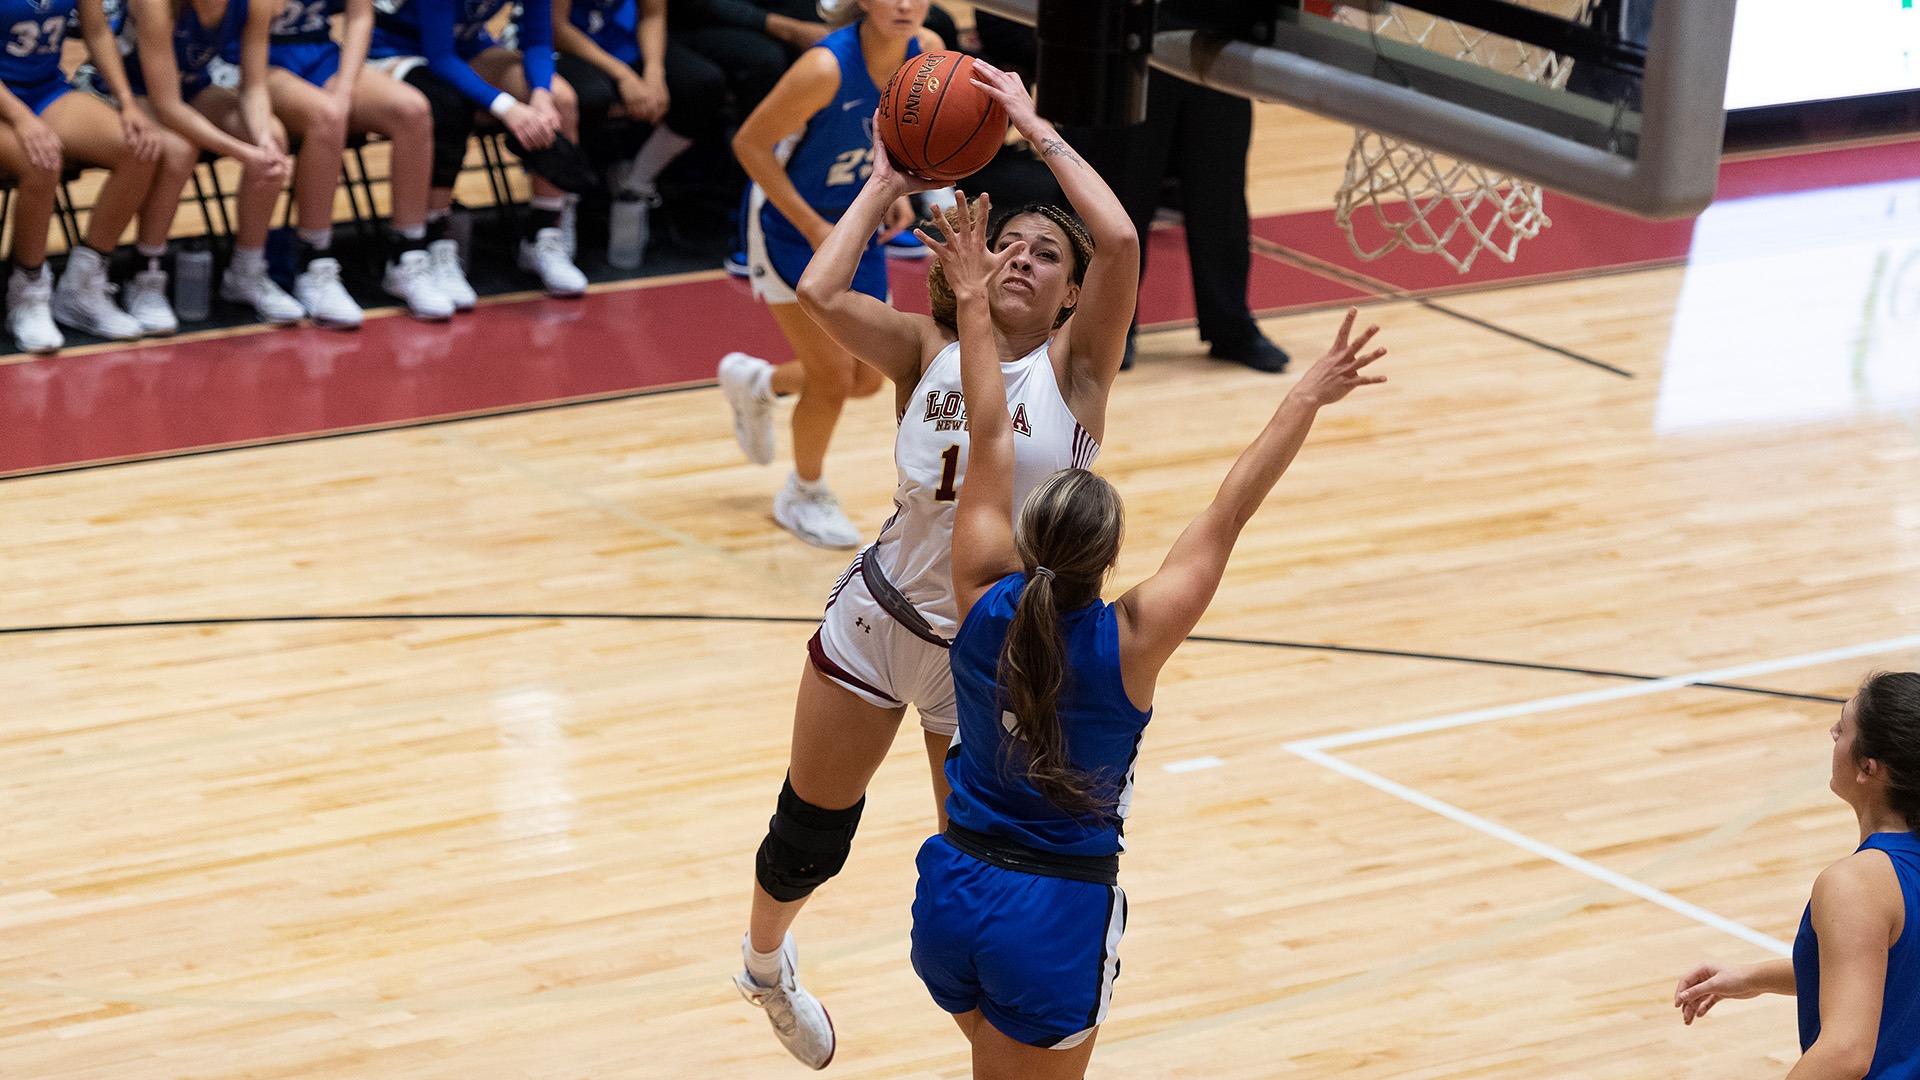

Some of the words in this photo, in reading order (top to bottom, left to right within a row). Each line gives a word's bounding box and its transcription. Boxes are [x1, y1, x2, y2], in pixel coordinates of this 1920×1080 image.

[901, 53, 947, 126] SPALDING
[923, 389, 1032, 437] LOA
[935, 419, 963, 432] NEW
